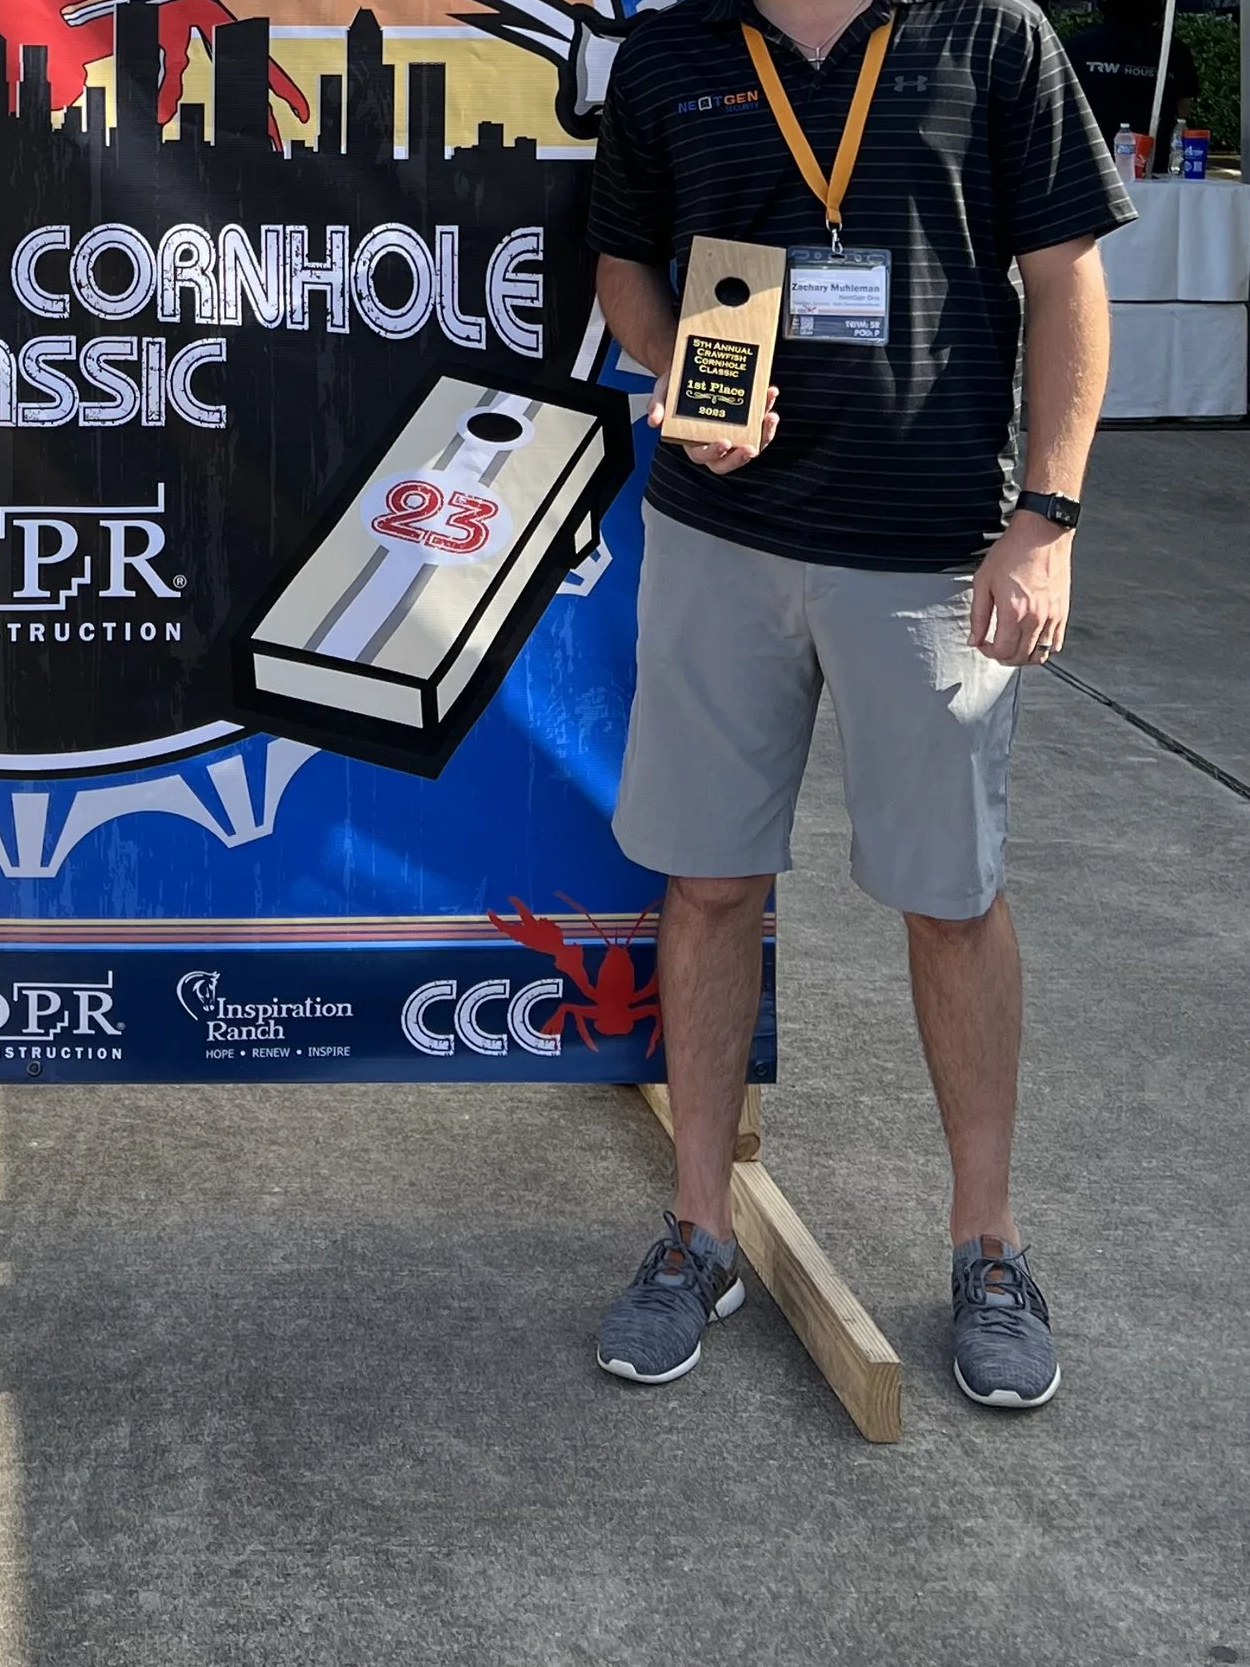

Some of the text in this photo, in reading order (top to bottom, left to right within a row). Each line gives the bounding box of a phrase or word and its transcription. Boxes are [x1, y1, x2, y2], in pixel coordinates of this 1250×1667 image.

[1086, 61, 1120, 74] TRW
[1124, 65, 1175, 80] HOUSN
[12, 222, 545, 359] CORNHOLE
[791, 282, 828, 294] Zachary
[696, 347, 747, 363] CRAWFISH
[713, 342, 754, 356] ANNUAL
[693, 356, 747, 371] CORNHOLE
[698, 364, 740, 378] CLASSIC
[686, 379, 746, 397] 1st Place
[698, 406, 727, 418] 2023
[371, 480, 499, 554] 23
[216, 996, 354, 1026] Inspiration
[401, 978, 564, 1057] CCC
[206, 1019, 286, 1042] Ranch
[205, 1046, 351, 1059] HOPE RENEW INSPIRE
